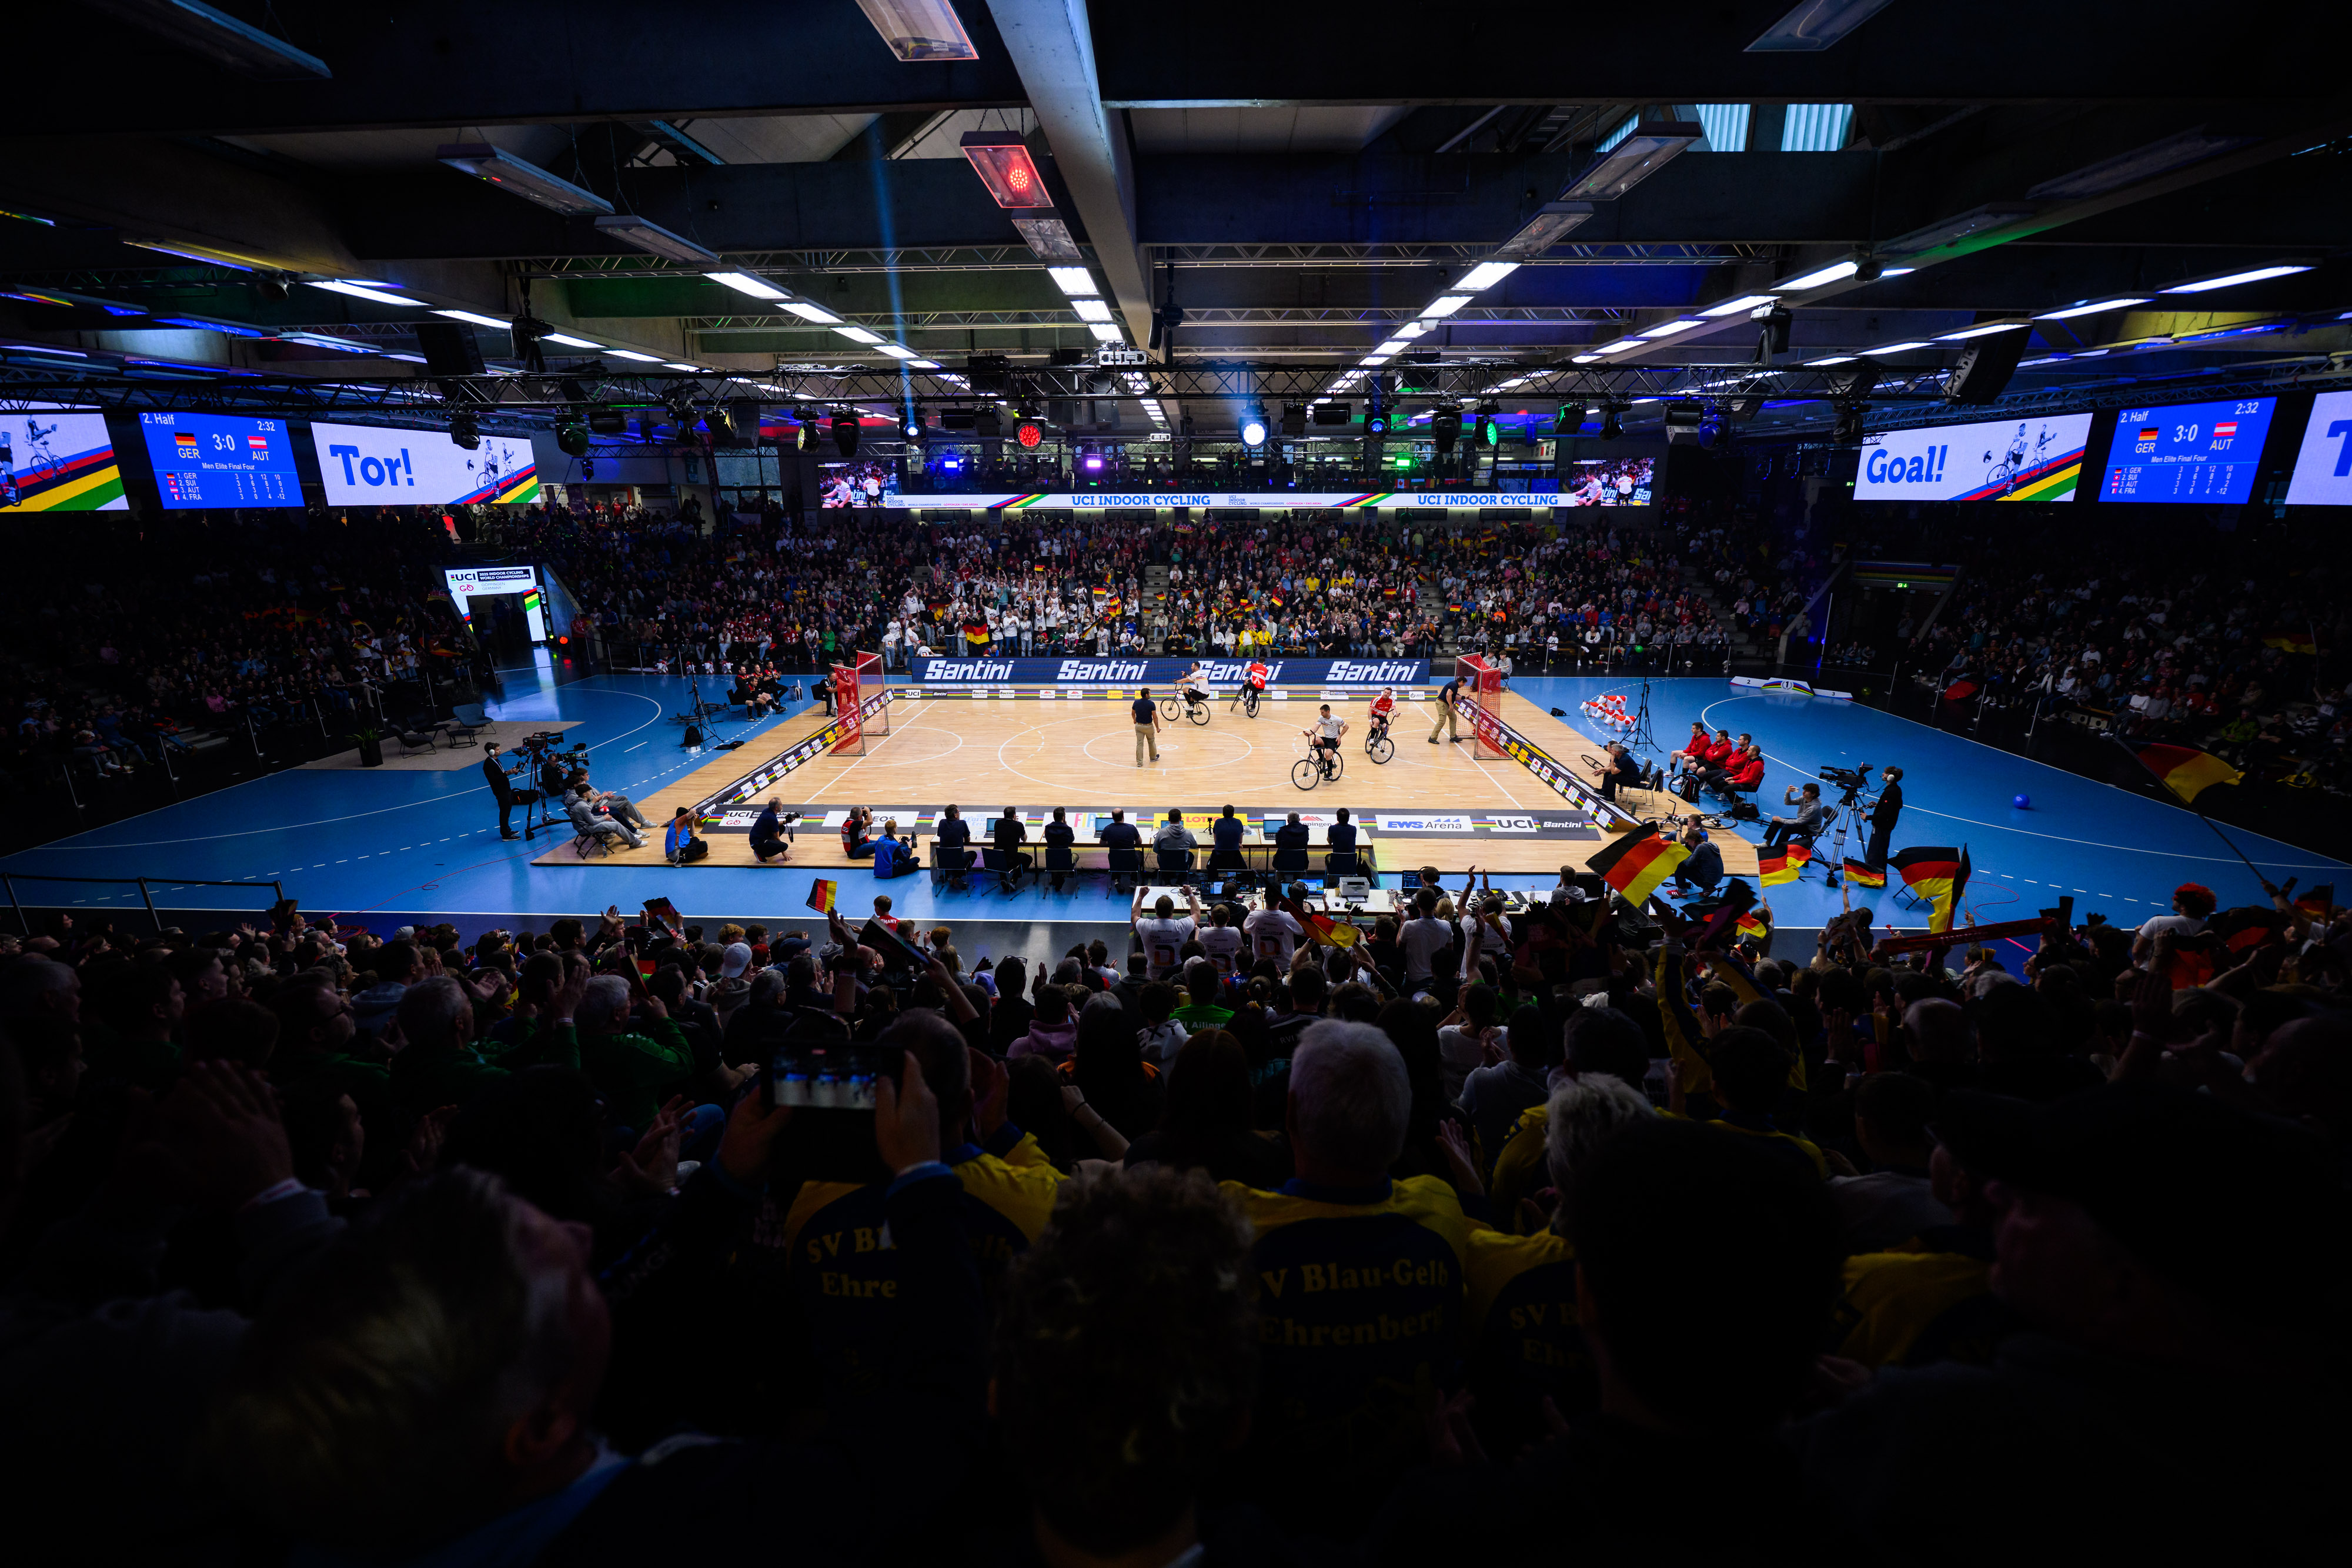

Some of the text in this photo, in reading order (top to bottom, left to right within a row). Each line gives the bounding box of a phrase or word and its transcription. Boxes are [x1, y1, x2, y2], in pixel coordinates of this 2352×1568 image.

[2235, 402, 2259, 414] 2:32
[143, 413, 175, 424] 2. Half
[2120, 411, 2149, 423] 2. Half
[257, 421, 275, 432] 2:32
[2174, 424, 2198, 442] 3:0
[212, 434, 235, 451] 3:0
[2136, 443, 2156, 453] GER
[2210, 439, 2233, 450] AUT
[178, 448, 201, 459] GER
[252, 451, 269, 461] AUT
[329, 444, 413, 487] Tor!
[1866, 444, 1948, 484] Goal!
[1071, 496, 1210, 506] UCI INDOOR CYCLING
[1418, 495, 1558, 506] UCI INDOOR CYCLING
[924, 660, 1014, 680] Santini
[1057, 660, 1148, 680] Santini
[1325, 661, 1421, 681] Santini
[1425, 821, 1462, 829] Arena
[1497, 820, 1534, 829] UCI
[1191, 1021, 1225, 1030] Ailinge
[807, 1231, 843, 1264] SV
[1299, 1257, 1449, 1293] Blau-Gelb
[1509, 1302, 1549, 1330] SV
